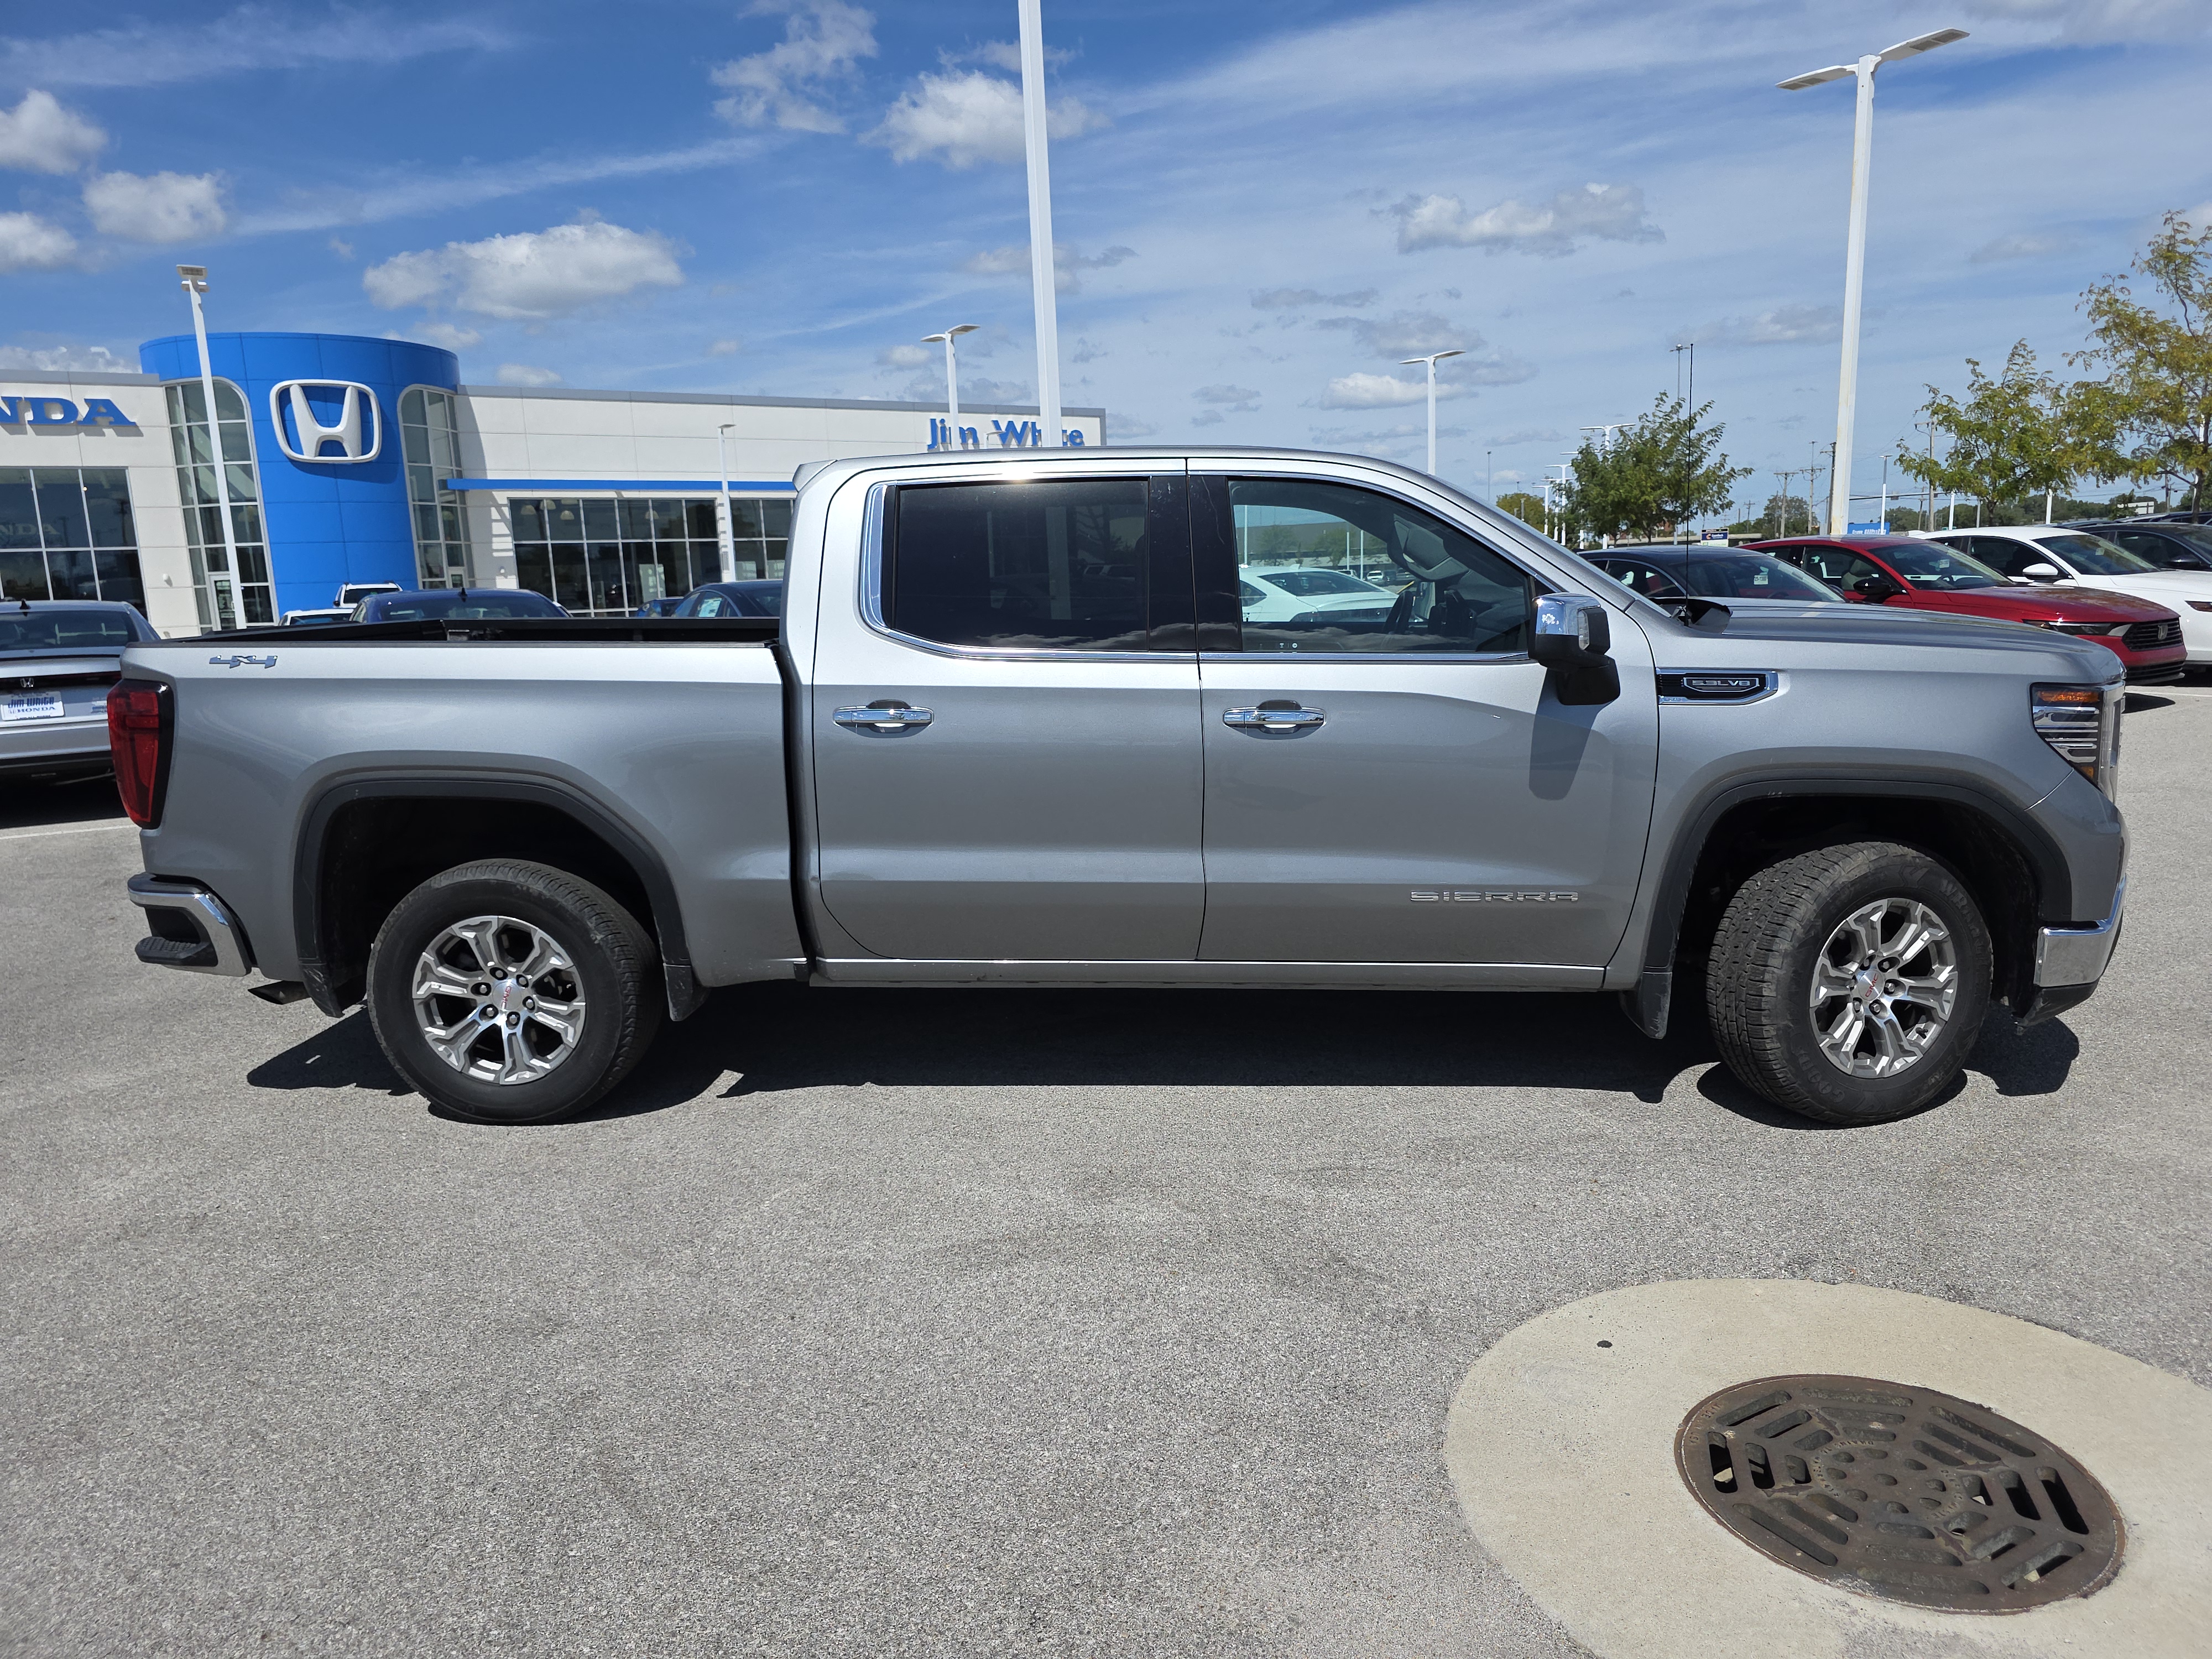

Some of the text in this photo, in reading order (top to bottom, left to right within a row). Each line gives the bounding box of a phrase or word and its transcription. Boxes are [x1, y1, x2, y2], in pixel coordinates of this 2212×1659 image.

[992, 420, 1083, 446] Whe
[1410, 891, 1578, 901] SIERRA
[501, 985, 512, 1009] GMC
[1865, 973, 1879, 998] GMC
